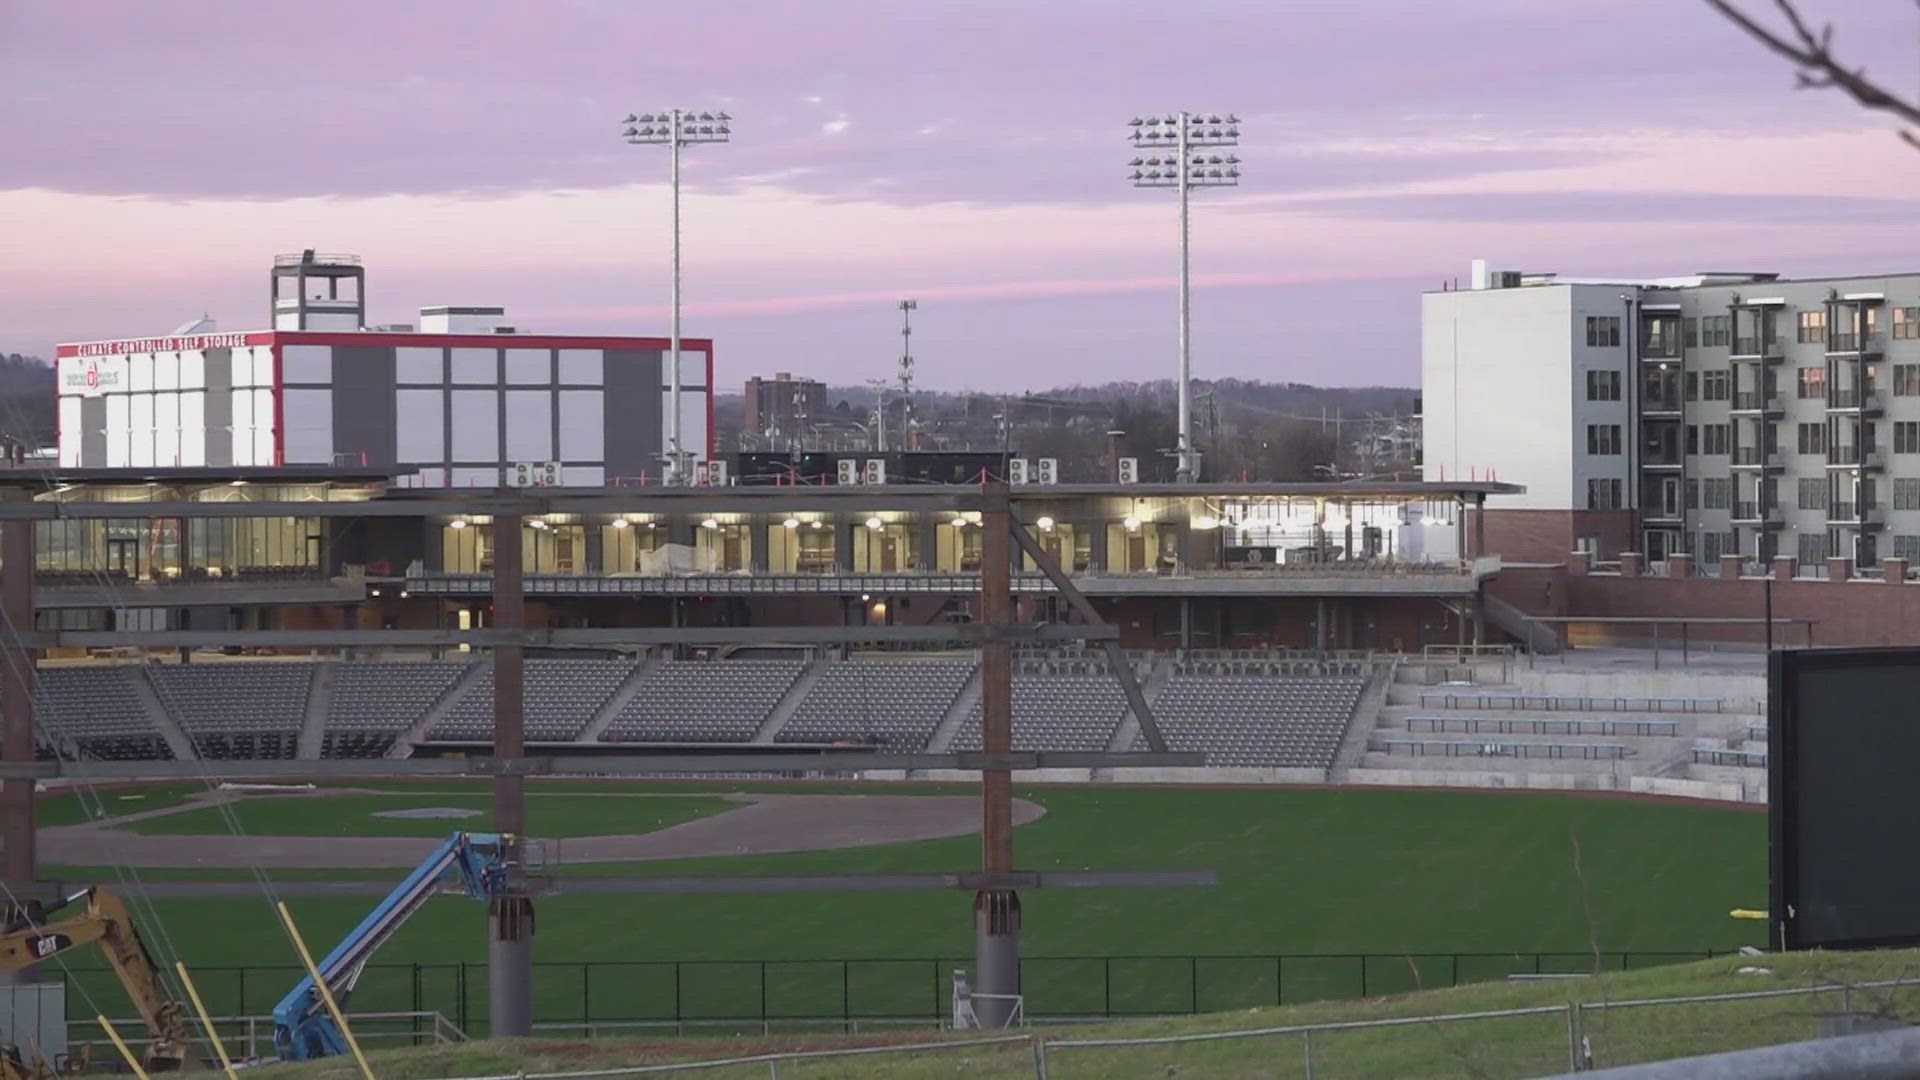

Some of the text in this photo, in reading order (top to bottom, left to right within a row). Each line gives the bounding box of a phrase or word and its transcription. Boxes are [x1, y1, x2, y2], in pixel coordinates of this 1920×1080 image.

[77, 334, 246, 357] CLIMATE CONTROLLED SELF STORAGE
[38, 935, 57, 956] CAT
